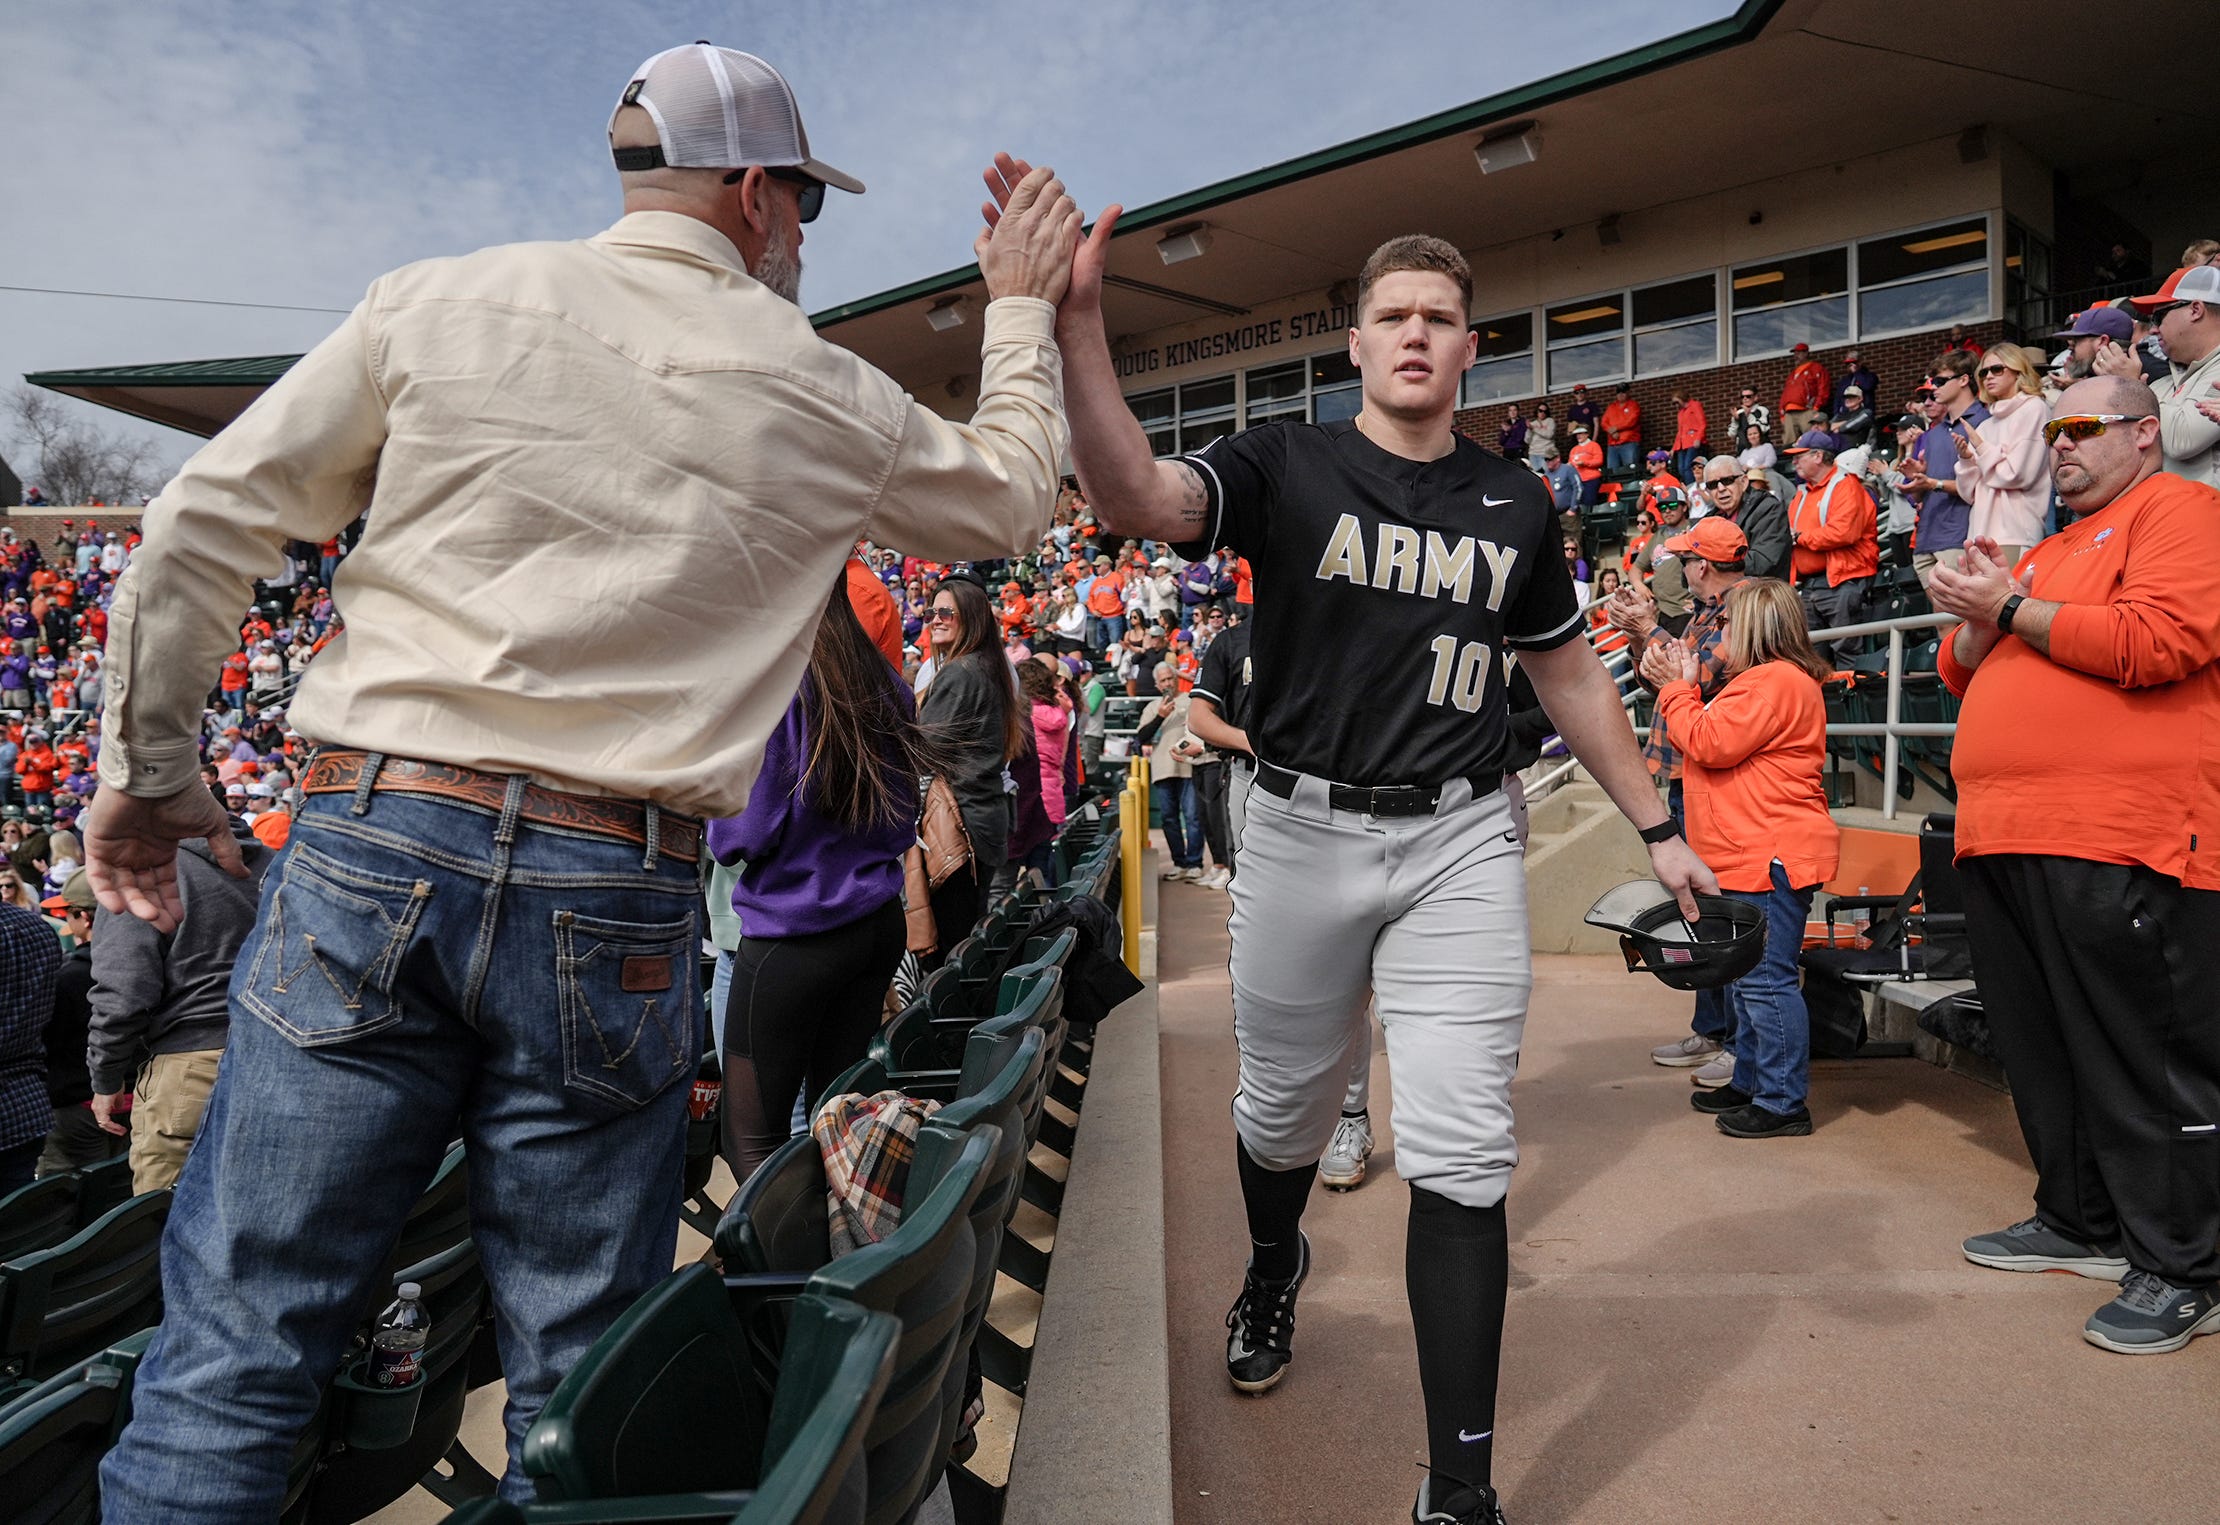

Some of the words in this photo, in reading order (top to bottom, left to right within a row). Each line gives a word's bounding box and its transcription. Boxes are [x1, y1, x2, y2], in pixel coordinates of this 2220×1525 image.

[1166, 319, 1283, 368] KINGSMORE
[1290, 302, 1358, 341] STADI
[1315, 512, 1519, 613] ARMY
[1426, 633, 1492, 714] 10
